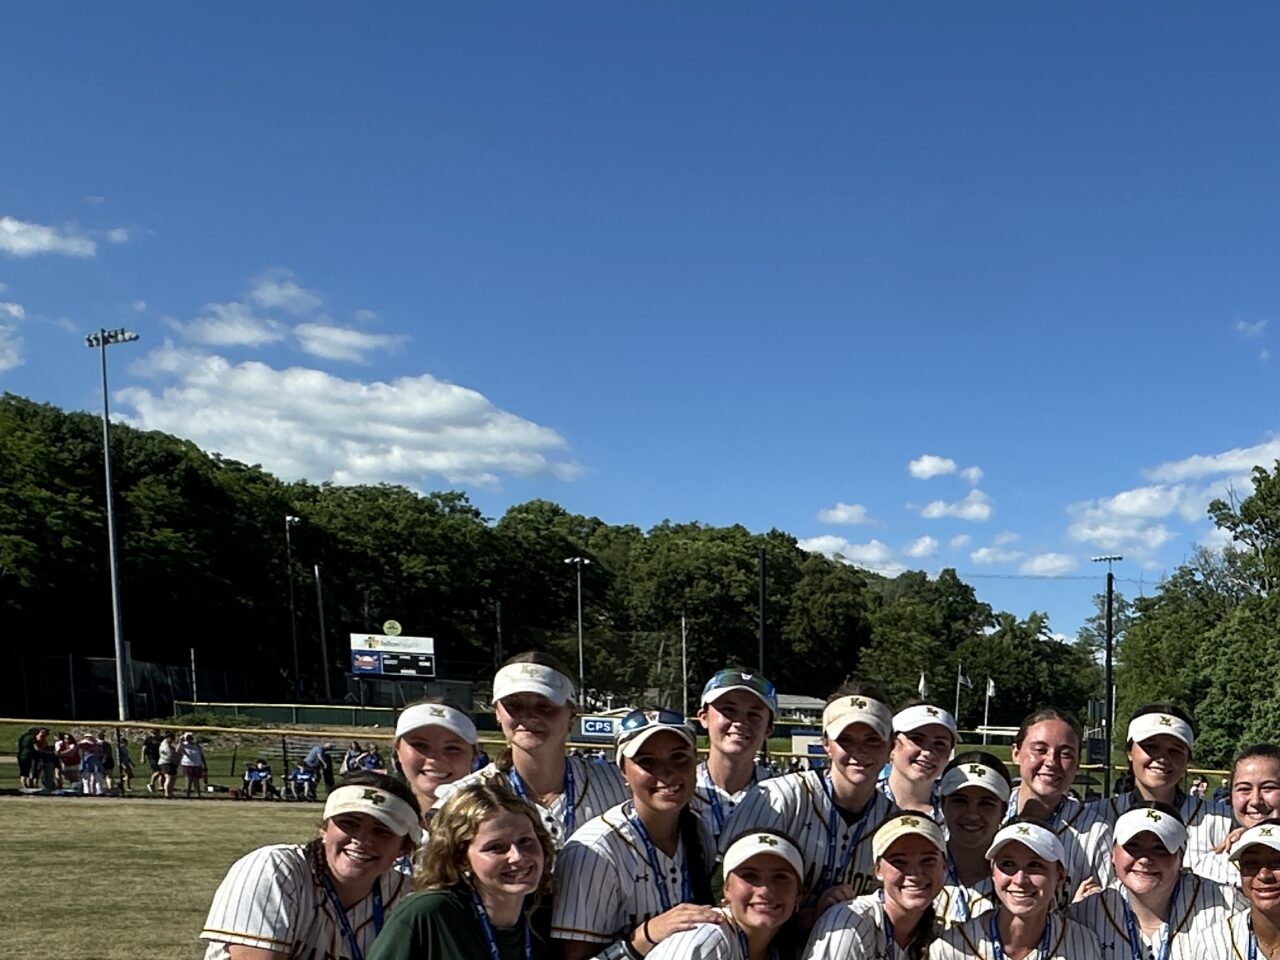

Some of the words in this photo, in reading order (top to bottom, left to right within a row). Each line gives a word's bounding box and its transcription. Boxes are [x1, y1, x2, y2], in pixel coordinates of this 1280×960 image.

[585, 721, 611, 732] CPS
[969, 765, 987, 777] KP
[1146, 810, 1162, 823] KP
